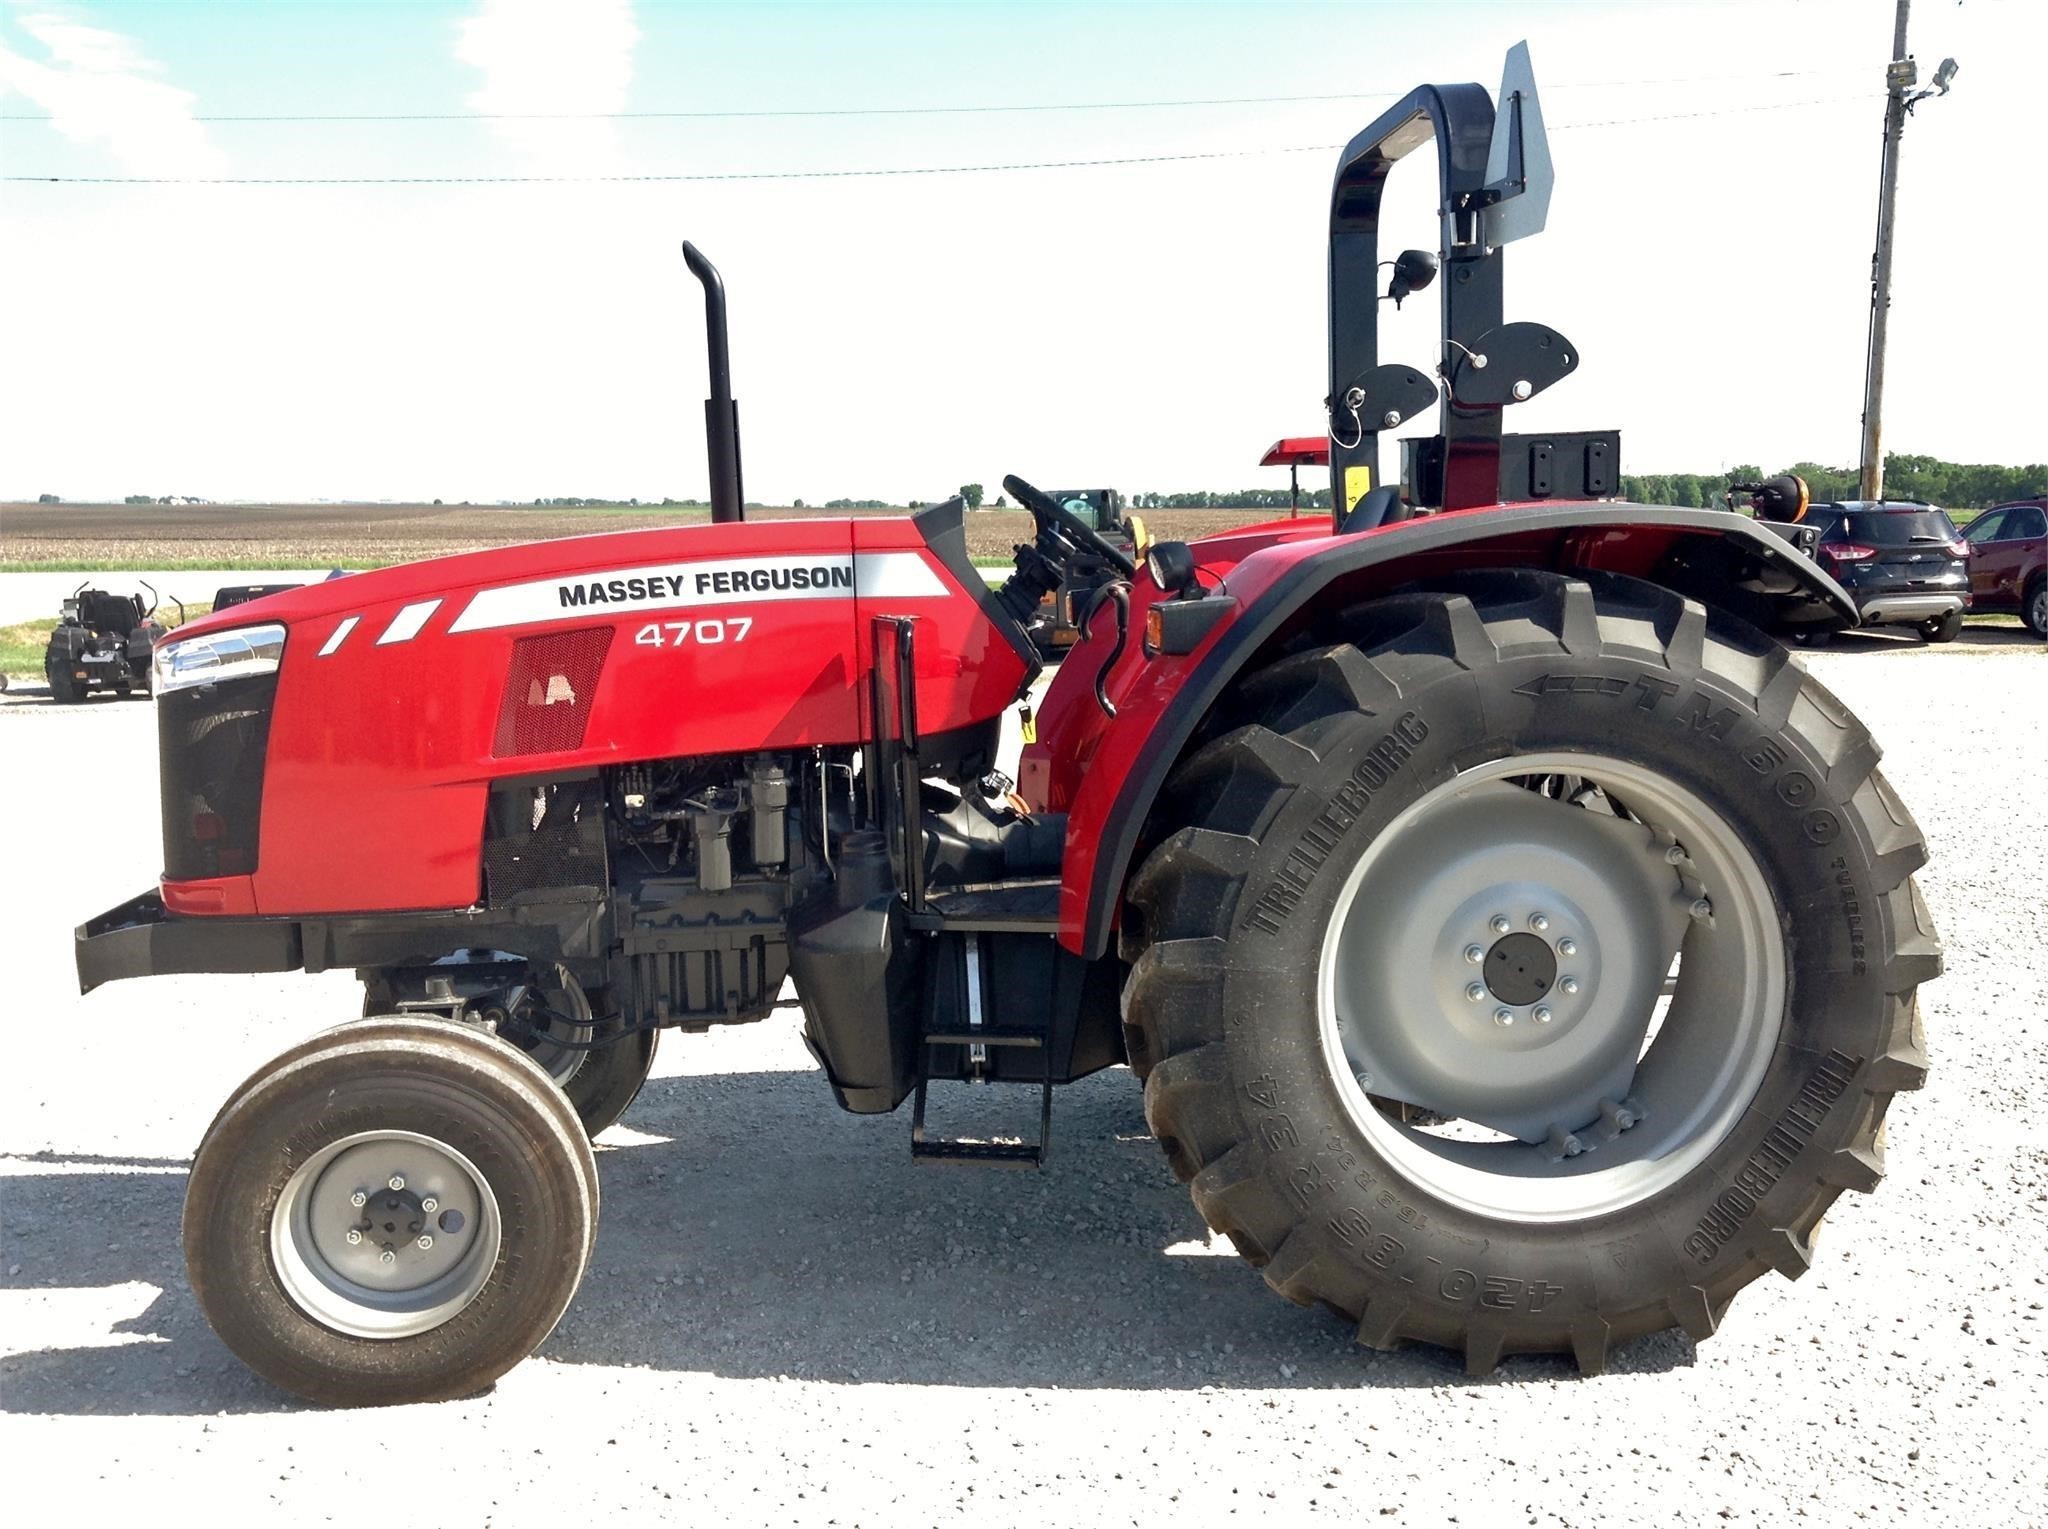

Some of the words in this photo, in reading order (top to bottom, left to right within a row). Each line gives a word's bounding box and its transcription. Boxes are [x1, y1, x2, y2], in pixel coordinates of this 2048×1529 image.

[558, 575, 685, 607] MASSEY
[695, 566, 852, 595] FERGUSON
[635, 616, 753, 648] 4707
[1240, 710, 1430, 937] TRELLEBORG
[1634, 672, 1742, 743] TM
[1742, 734, 1842, 846] 600
[1683, 1047, 1866, 1265] TRELLEBORG
